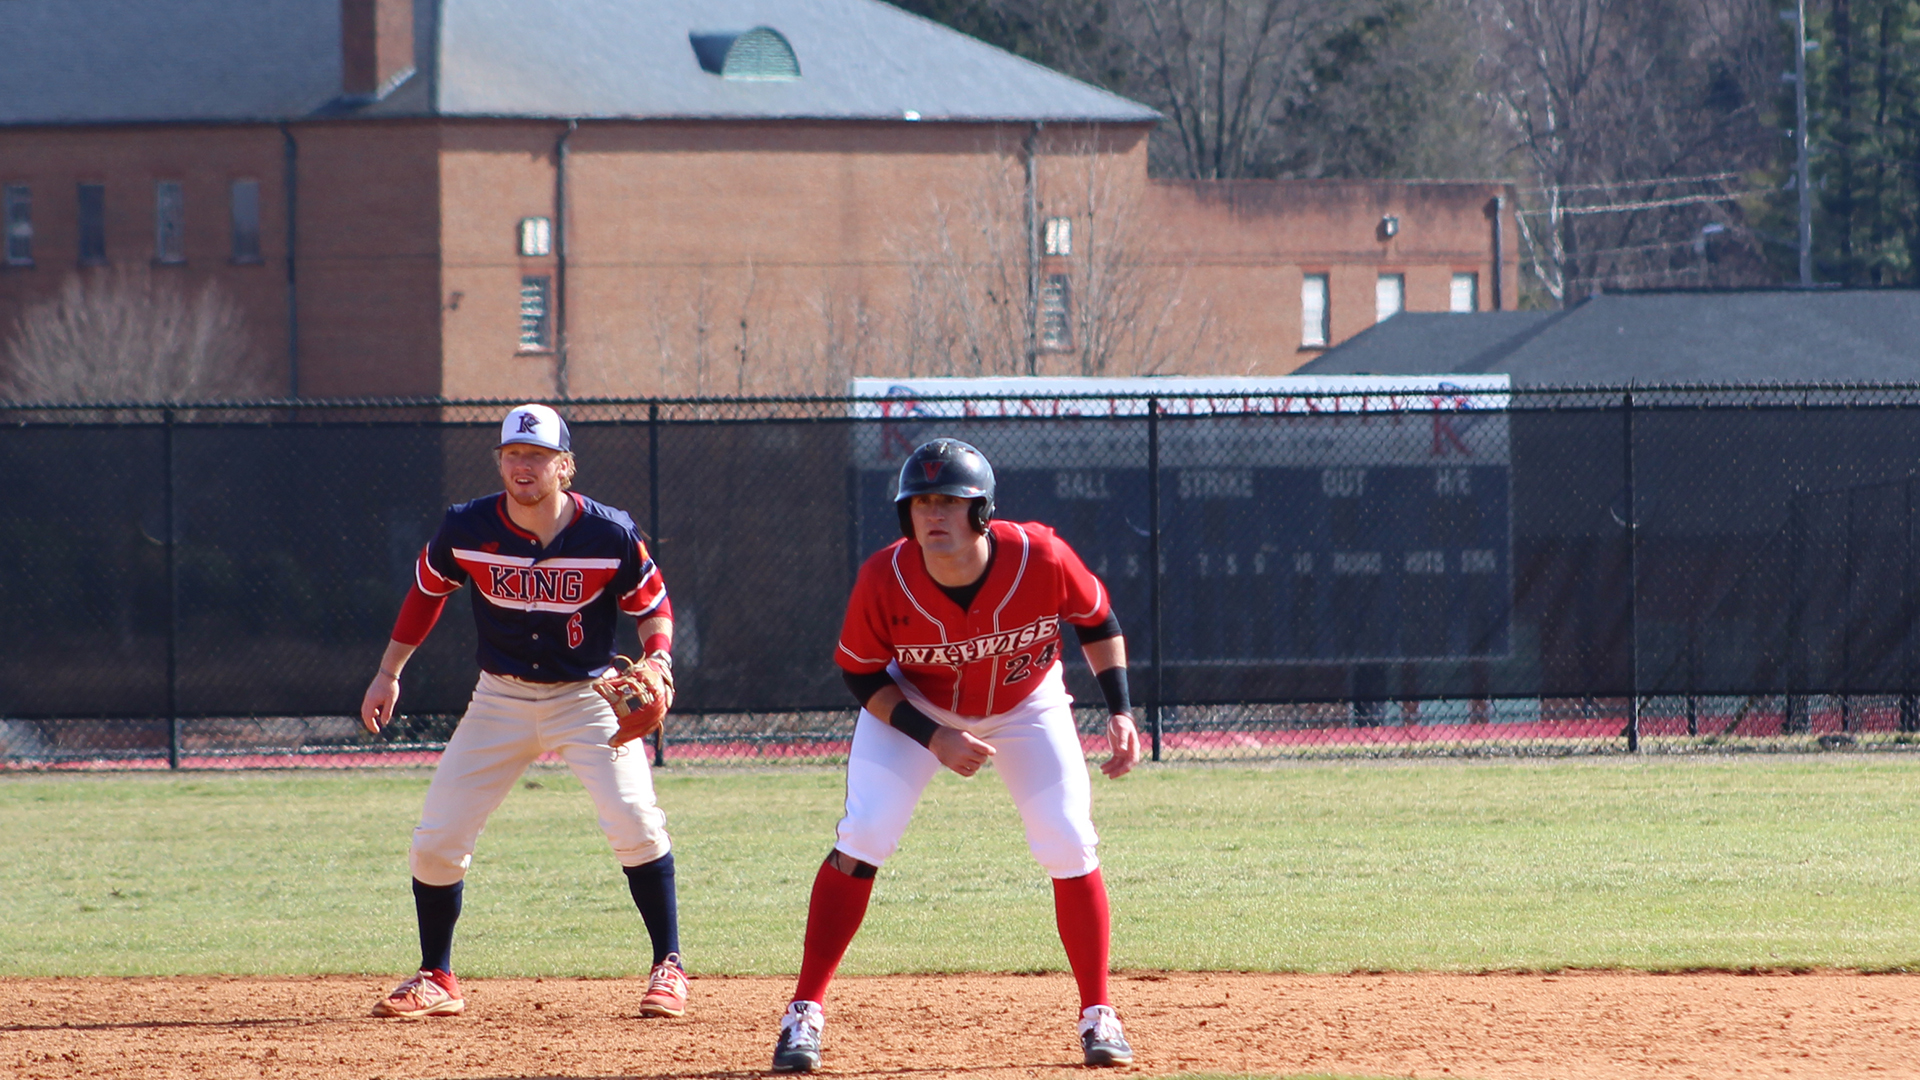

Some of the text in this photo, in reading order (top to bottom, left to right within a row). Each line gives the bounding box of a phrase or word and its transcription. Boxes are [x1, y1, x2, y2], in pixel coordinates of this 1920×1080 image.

[921, 460, 946, 483] V
[1056, 473, 1109, 499] BALL
[1178, 470, 1254, 499] STRIKE
[1321, 469, 1366, 498] OUT
[489, 565, 583, 602] KING
[567, 612, 584, 649] 6
[1003, 639, 1060, 686] 24
